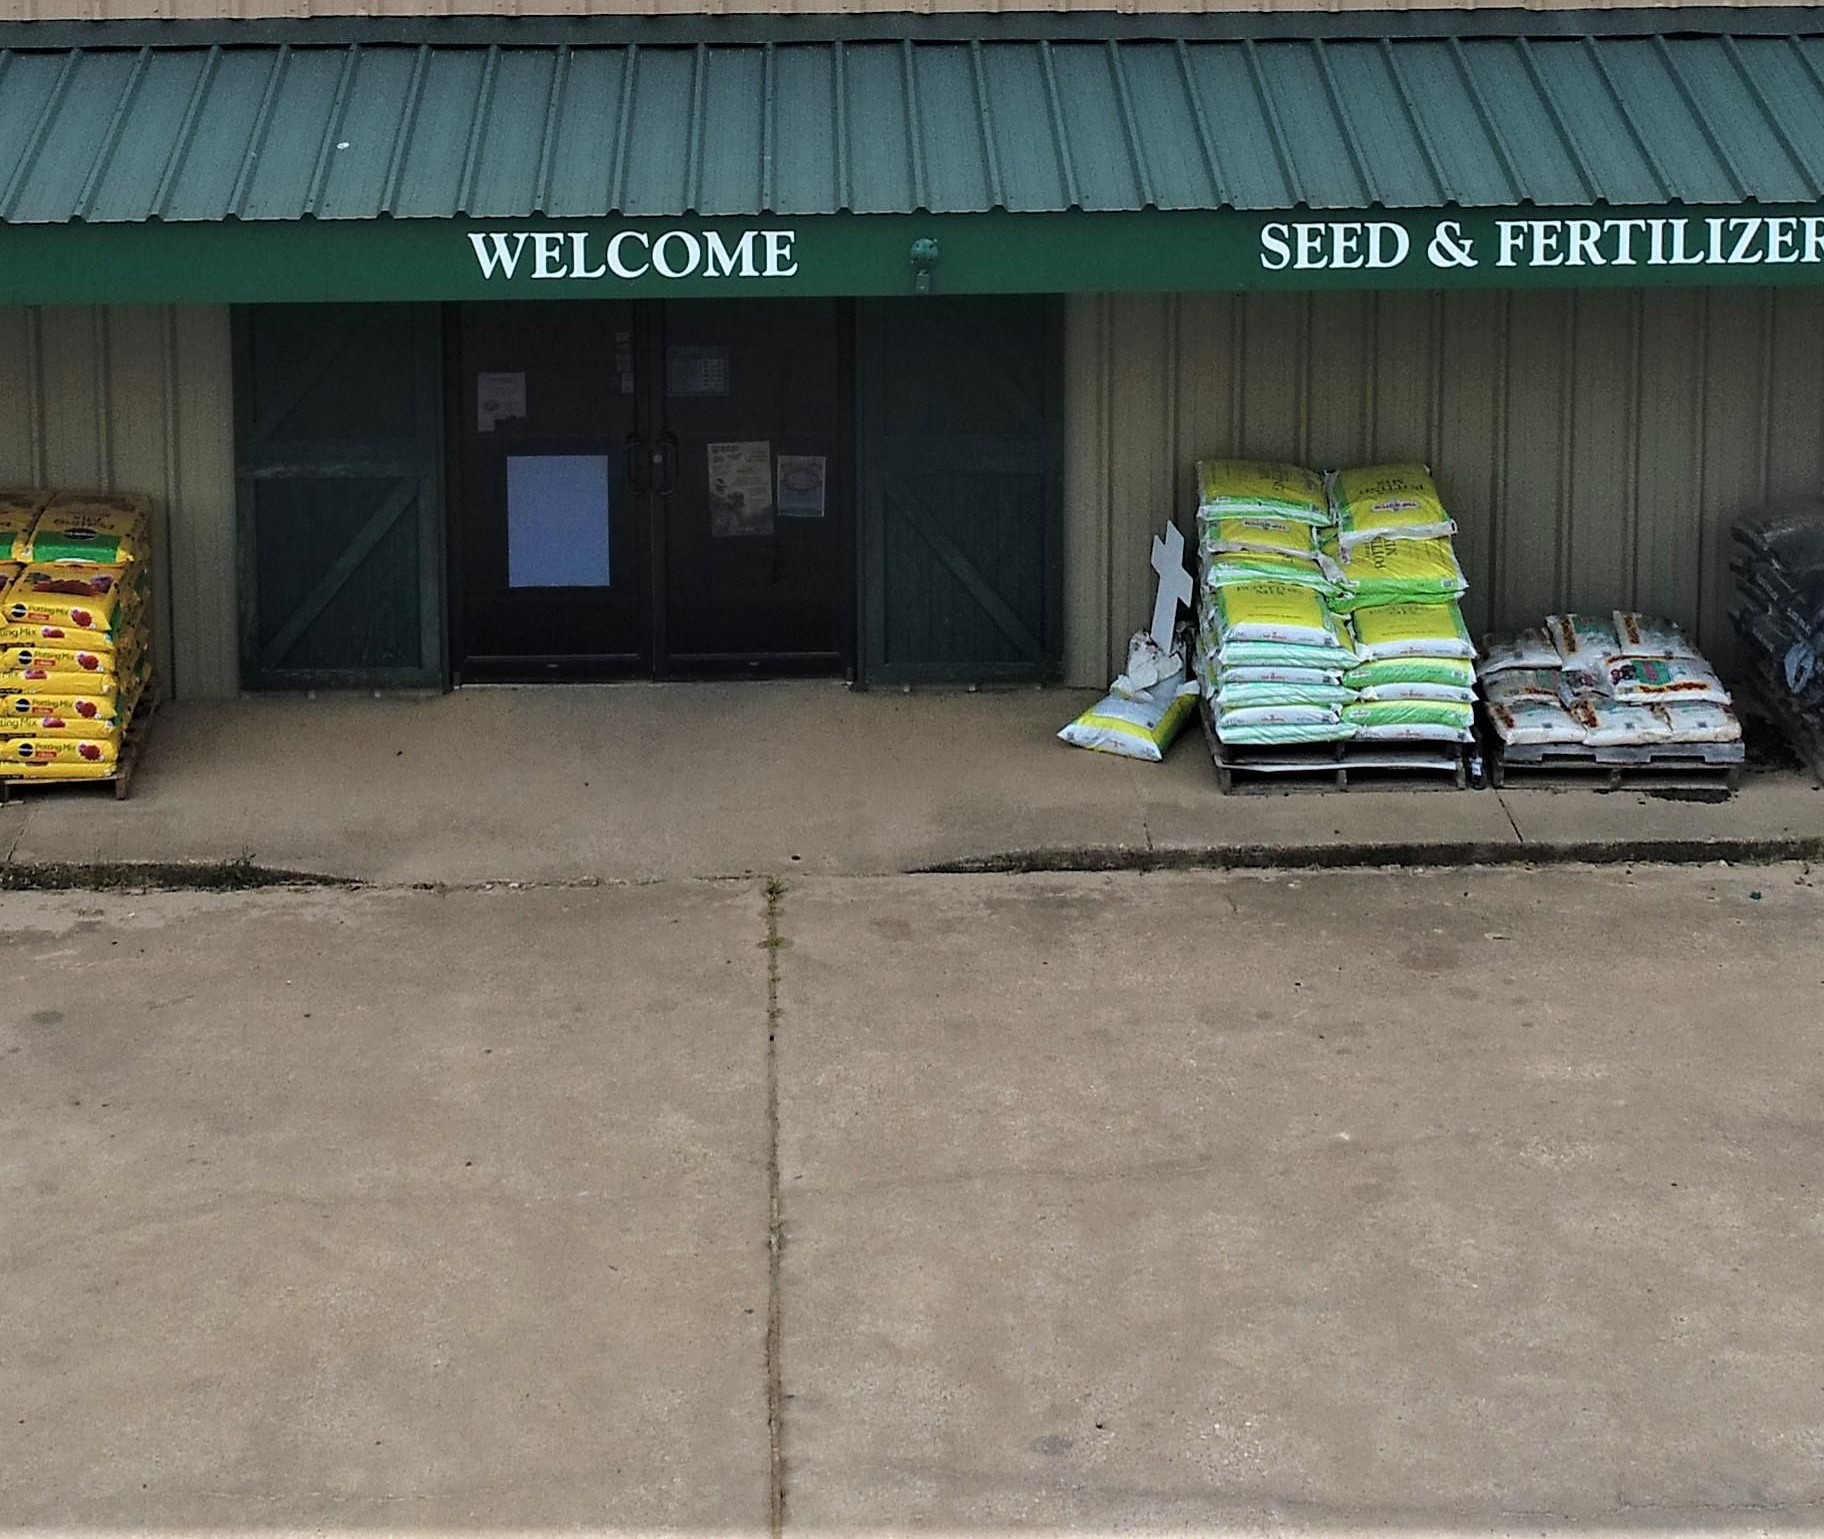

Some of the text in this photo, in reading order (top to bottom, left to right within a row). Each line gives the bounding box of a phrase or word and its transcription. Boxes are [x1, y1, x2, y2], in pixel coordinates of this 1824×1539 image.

[467, 230, 798, 279] WELCOME
[1260, 222, 1410, 270] SEED
[1427, 221, 1479, 268] &
